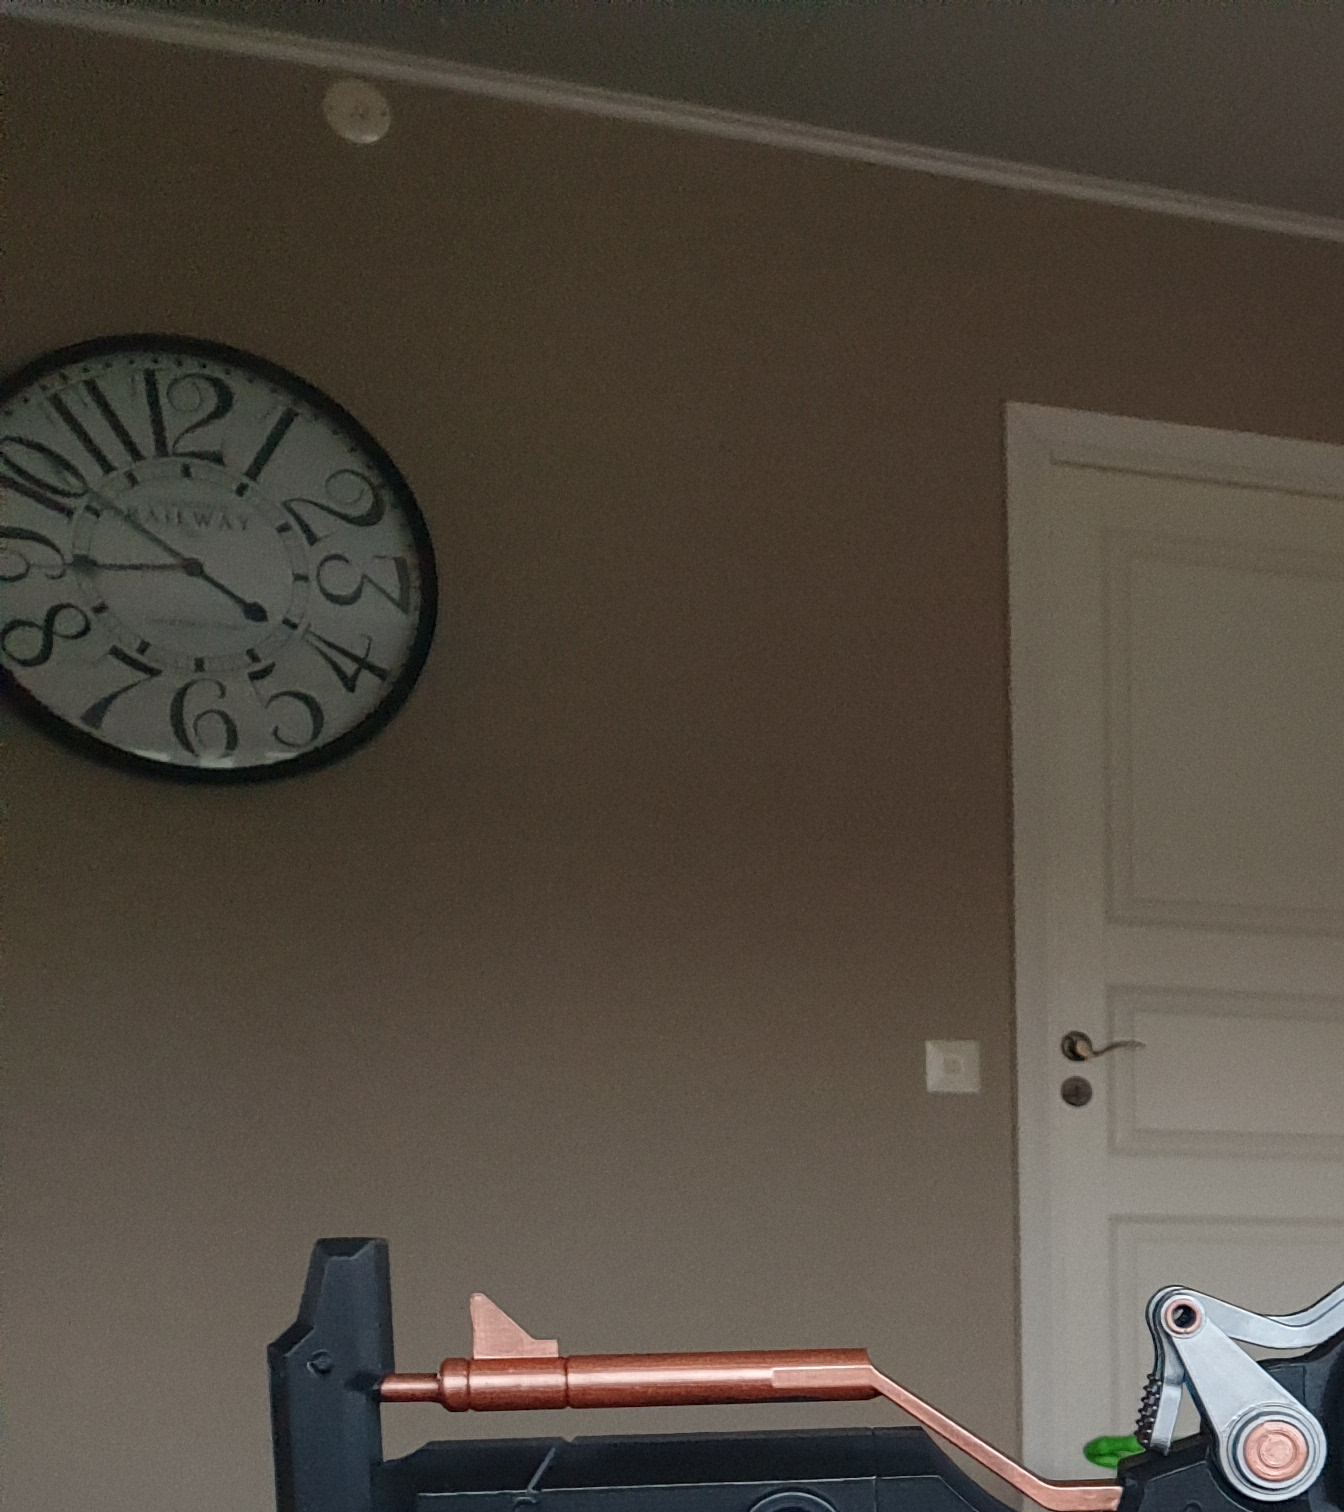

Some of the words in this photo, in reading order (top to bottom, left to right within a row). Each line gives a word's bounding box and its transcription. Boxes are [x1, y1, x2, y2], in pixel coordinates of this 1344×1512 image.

[48, 378, 146, 474] 11
[143, 368, 235, 466] 12
[243, 407, 299, 483] 1
[282, 468, 386, 546] 2
[315, 553, 409, 615] 3
[0, 602, 91, 667] 8
[304, 624, 391, 693] 4
[80, 644, 163, 728] 7
[170, 677, 239, 757] 6
[249, 661, 325, 748] 5
